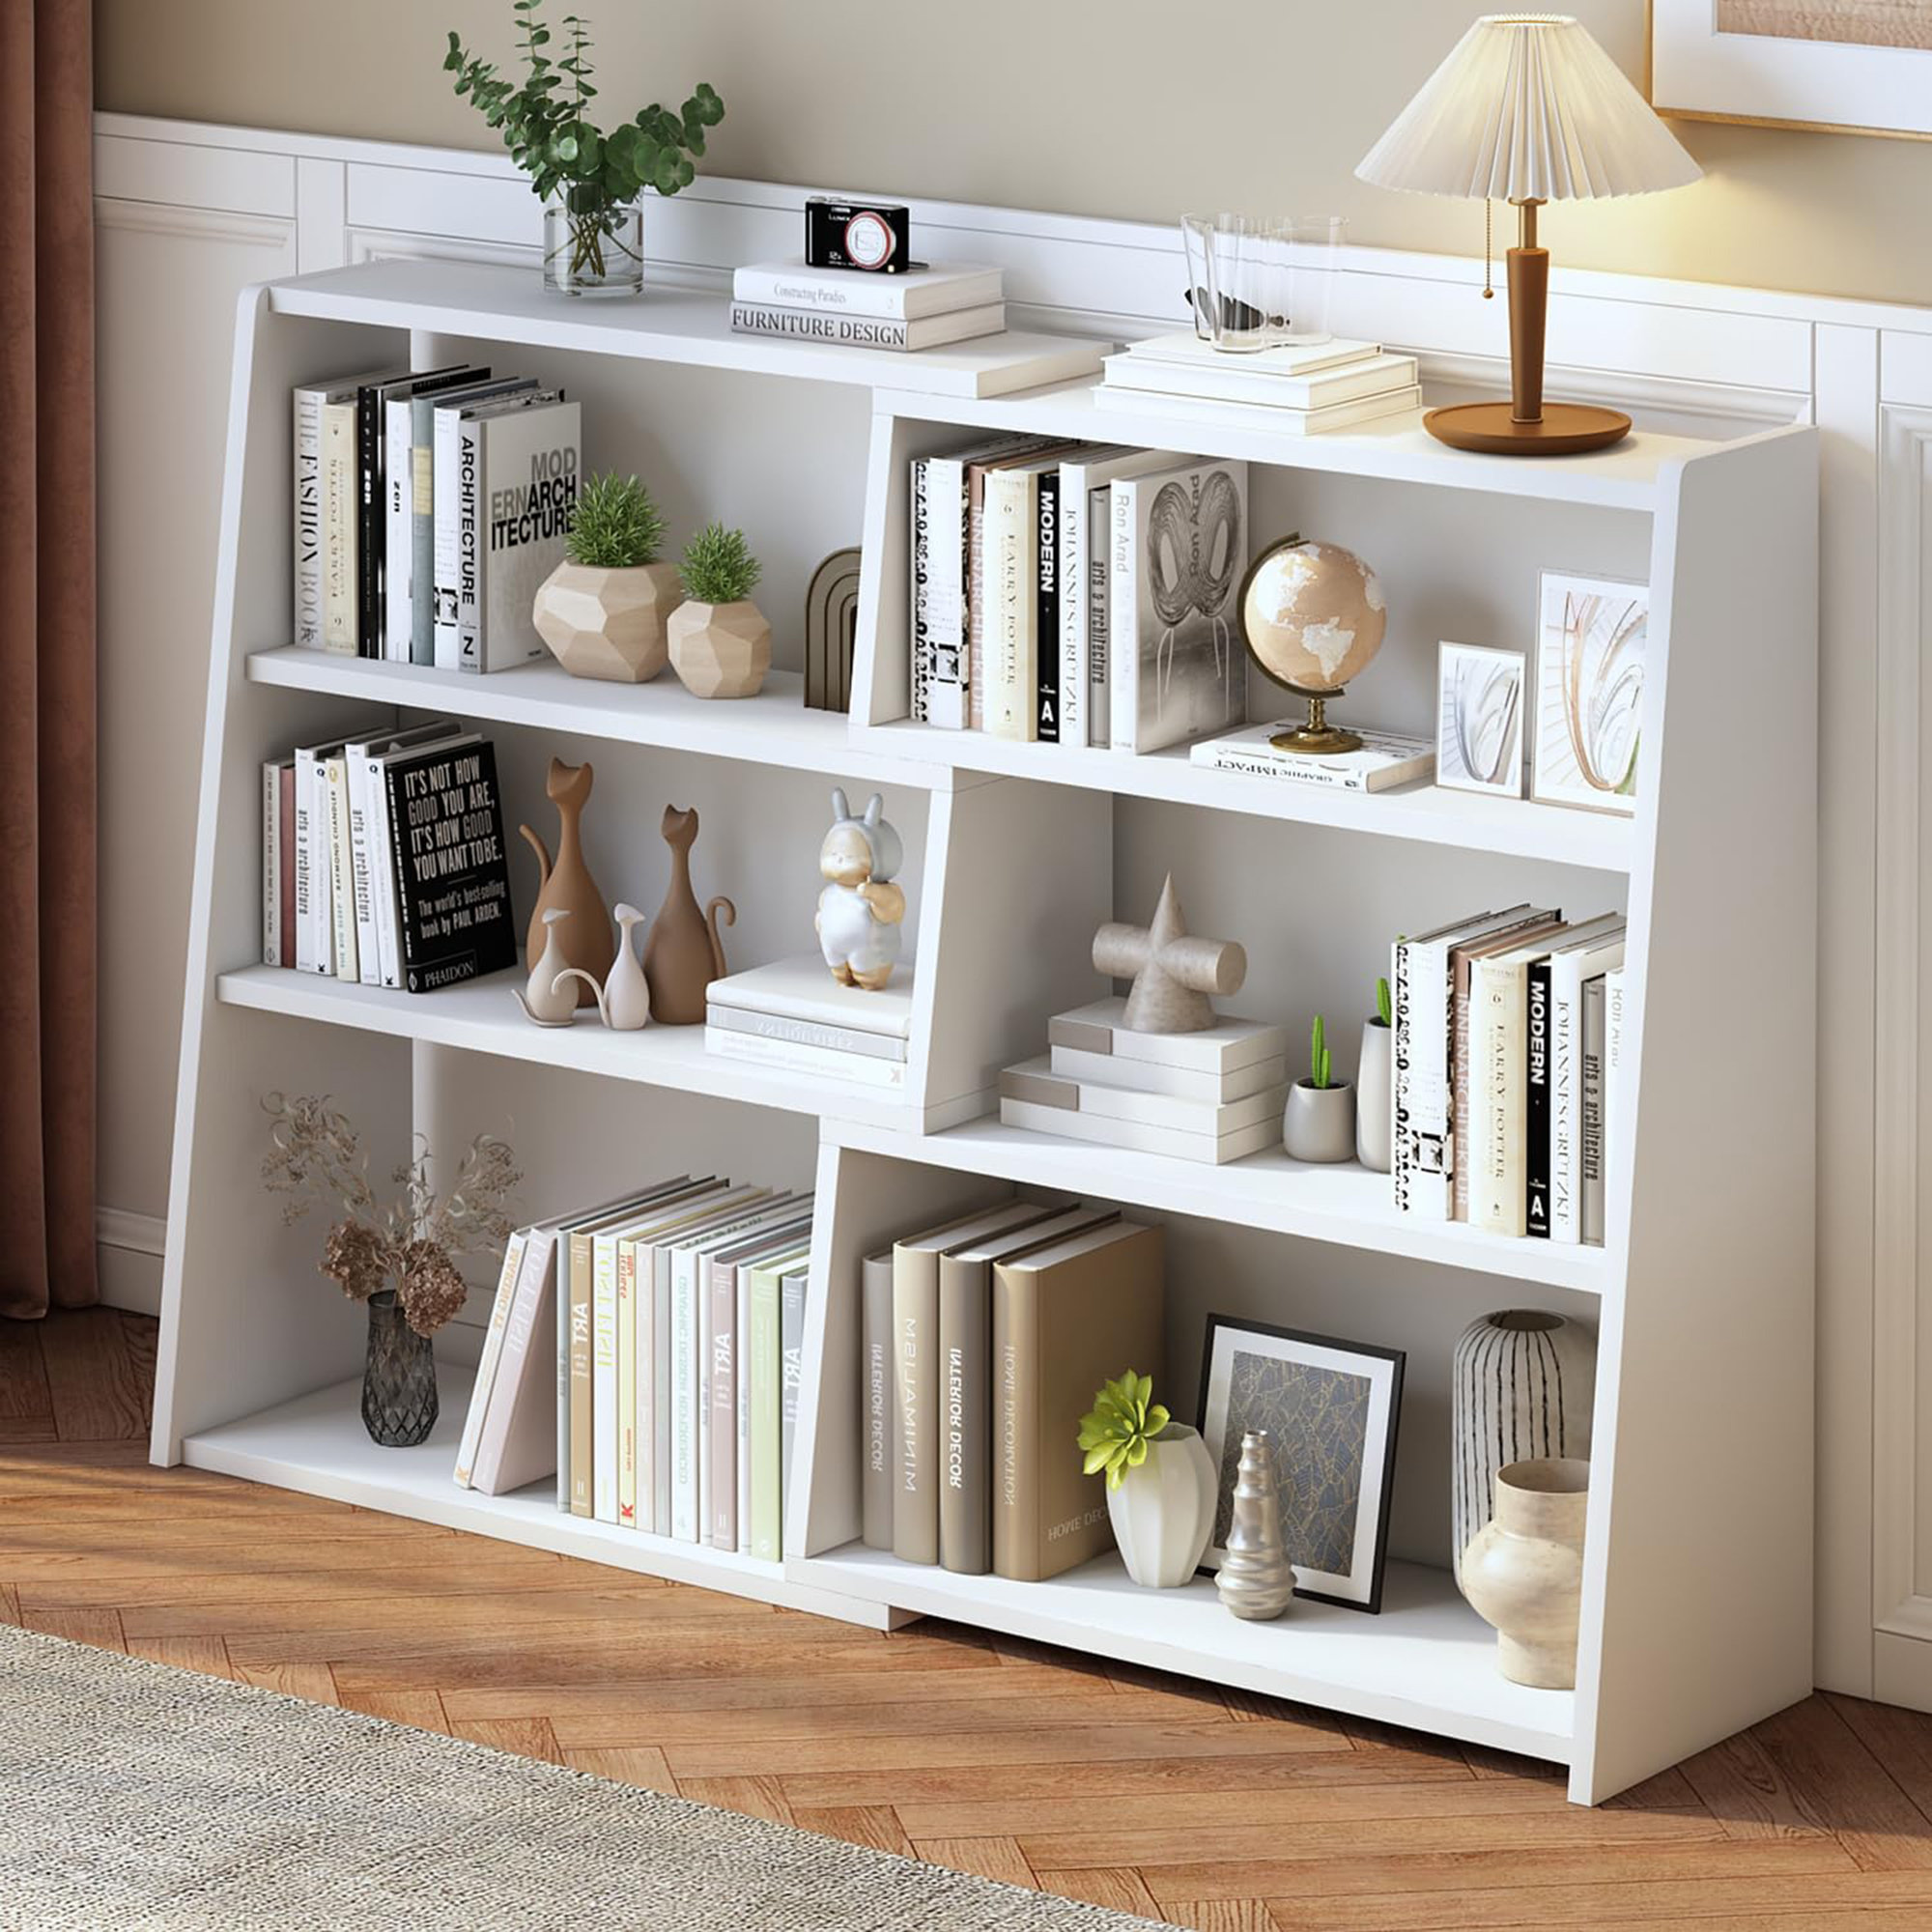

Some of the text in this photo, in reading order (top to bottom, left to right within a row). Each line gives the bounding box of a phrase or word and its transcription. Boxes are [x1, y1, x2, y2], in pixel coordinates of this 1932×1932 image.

[732, 308, 905, 346] FURNITURE DESIGN
[299, 394, 319, 449] THE
[531, 446, 578, 483] MOD
[363, 469, 372, 505] zen
[299, 454, 319, 564] FASHION
[461, 436, 475, 606] ARCHITECTURE
[1115, 494, 1130, 527] Ron
[1189, 473, 1201, 577] Ron Arad
[1040, 491, 1055, 593] MODERN
[1115, 532, 1130, 574] Arad
[1092, 560, 1105, 587] arts
[1092, 606, 1107, 685] architecture
[1040, 699, 1055, 723] A
[404, 754, 480, 799] IT'S NOT HOW
[1214, 758, 1278, 777] IMPACT
[1281, 768, 1333, 783] GRAPHIC
[298, 810, 309, 832] arts
[330, 790, 339, 840] CHANDLER
[353, 809, 365, 833] arts
[408, 781, 496, 827] GOOD YOU ARE,
[410, 810, 493, 855] IT'S HOW GOOD
[413, 835, 503, 883] YOU WANT TO BE.
[298, 848, 310, 915] architecture
[355, 851, 371, 923] architecture
[417, 899, 433, 918] The
[419, 919, 440, 939] book
[440, 916, 451, 936] by
[452, 909, 473, 930] PAUL
[424, 960, 474, 988] PHAIDON
[1530, 980, 1546, 1085] MODERN
[1585, 1054, 1600, 1082] arts
[1584, 1101, 1601, 1180] architecture
[1531, 1195, 1546, 1217] A
